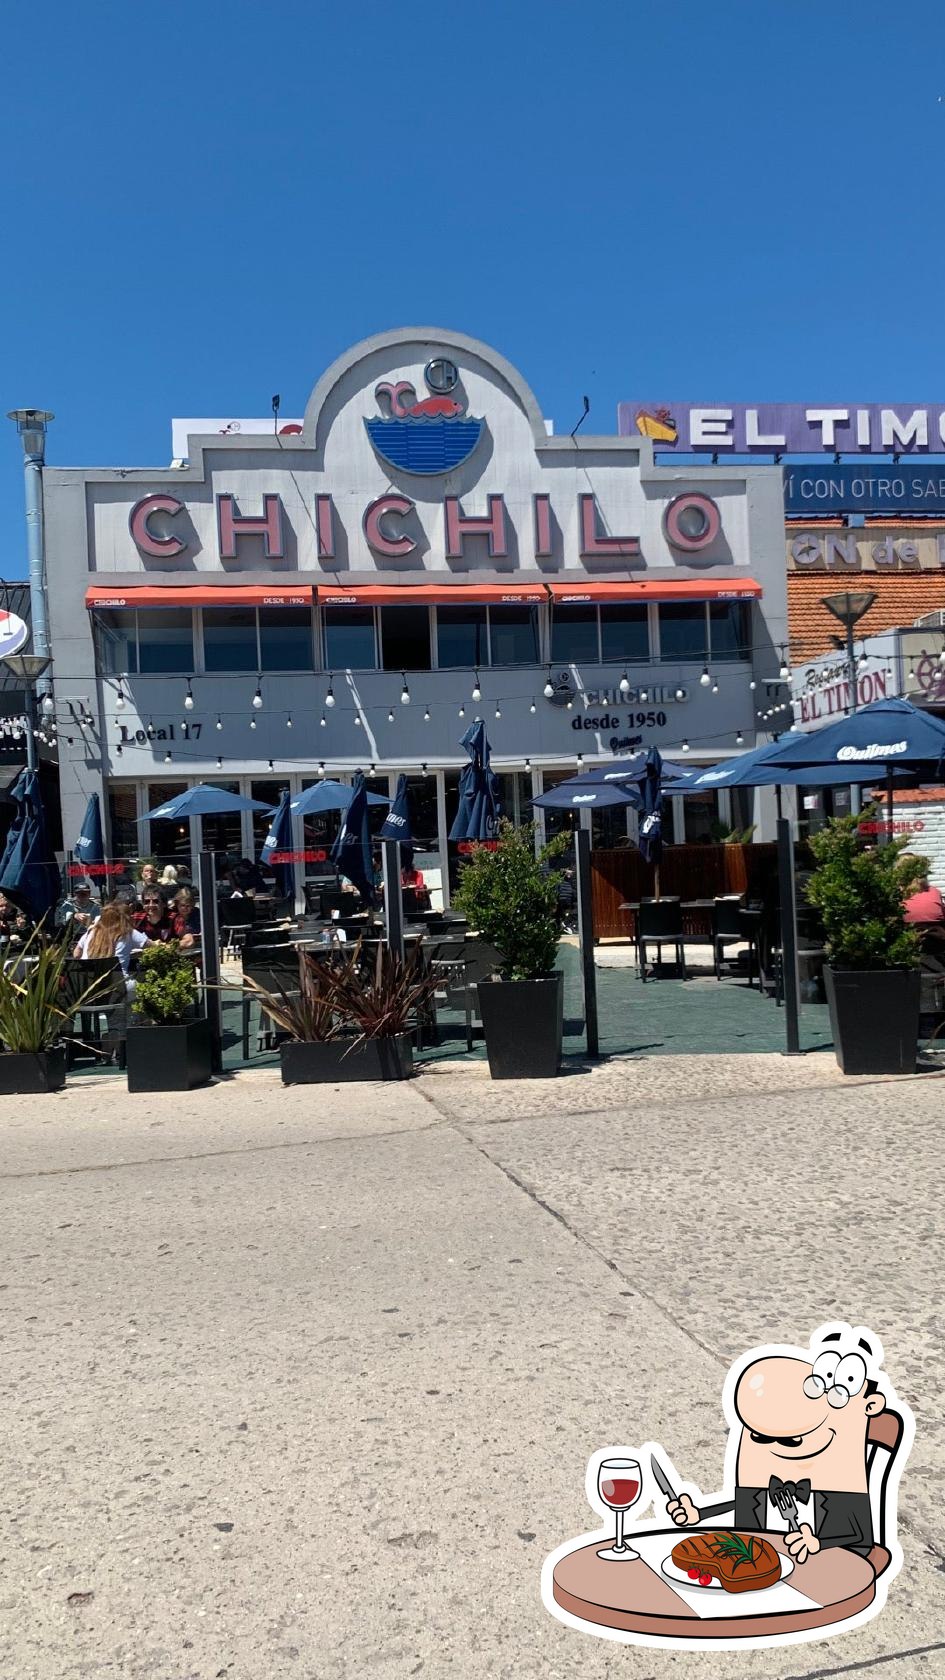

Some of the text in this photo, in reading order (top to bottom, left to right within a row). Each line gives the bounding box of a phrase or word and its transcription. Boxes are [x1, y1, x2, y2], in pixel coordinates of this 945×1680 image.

[689, 409, 945, 446] EL TIM
[801, 479, 844, 498] CON
[851, 479, 906, 498] OTRO
[128, 492, 722, 558] CHICHILO
[871, 535, 919, 565] de
[586, 686, 690, 706] CHICHILO
[799, 692, 822, 724] EL
[571, 711, 667, 730] desde 1950
[119, 723, 203, 746] Local 17
[836, 740, 908, 761] Quilmes
